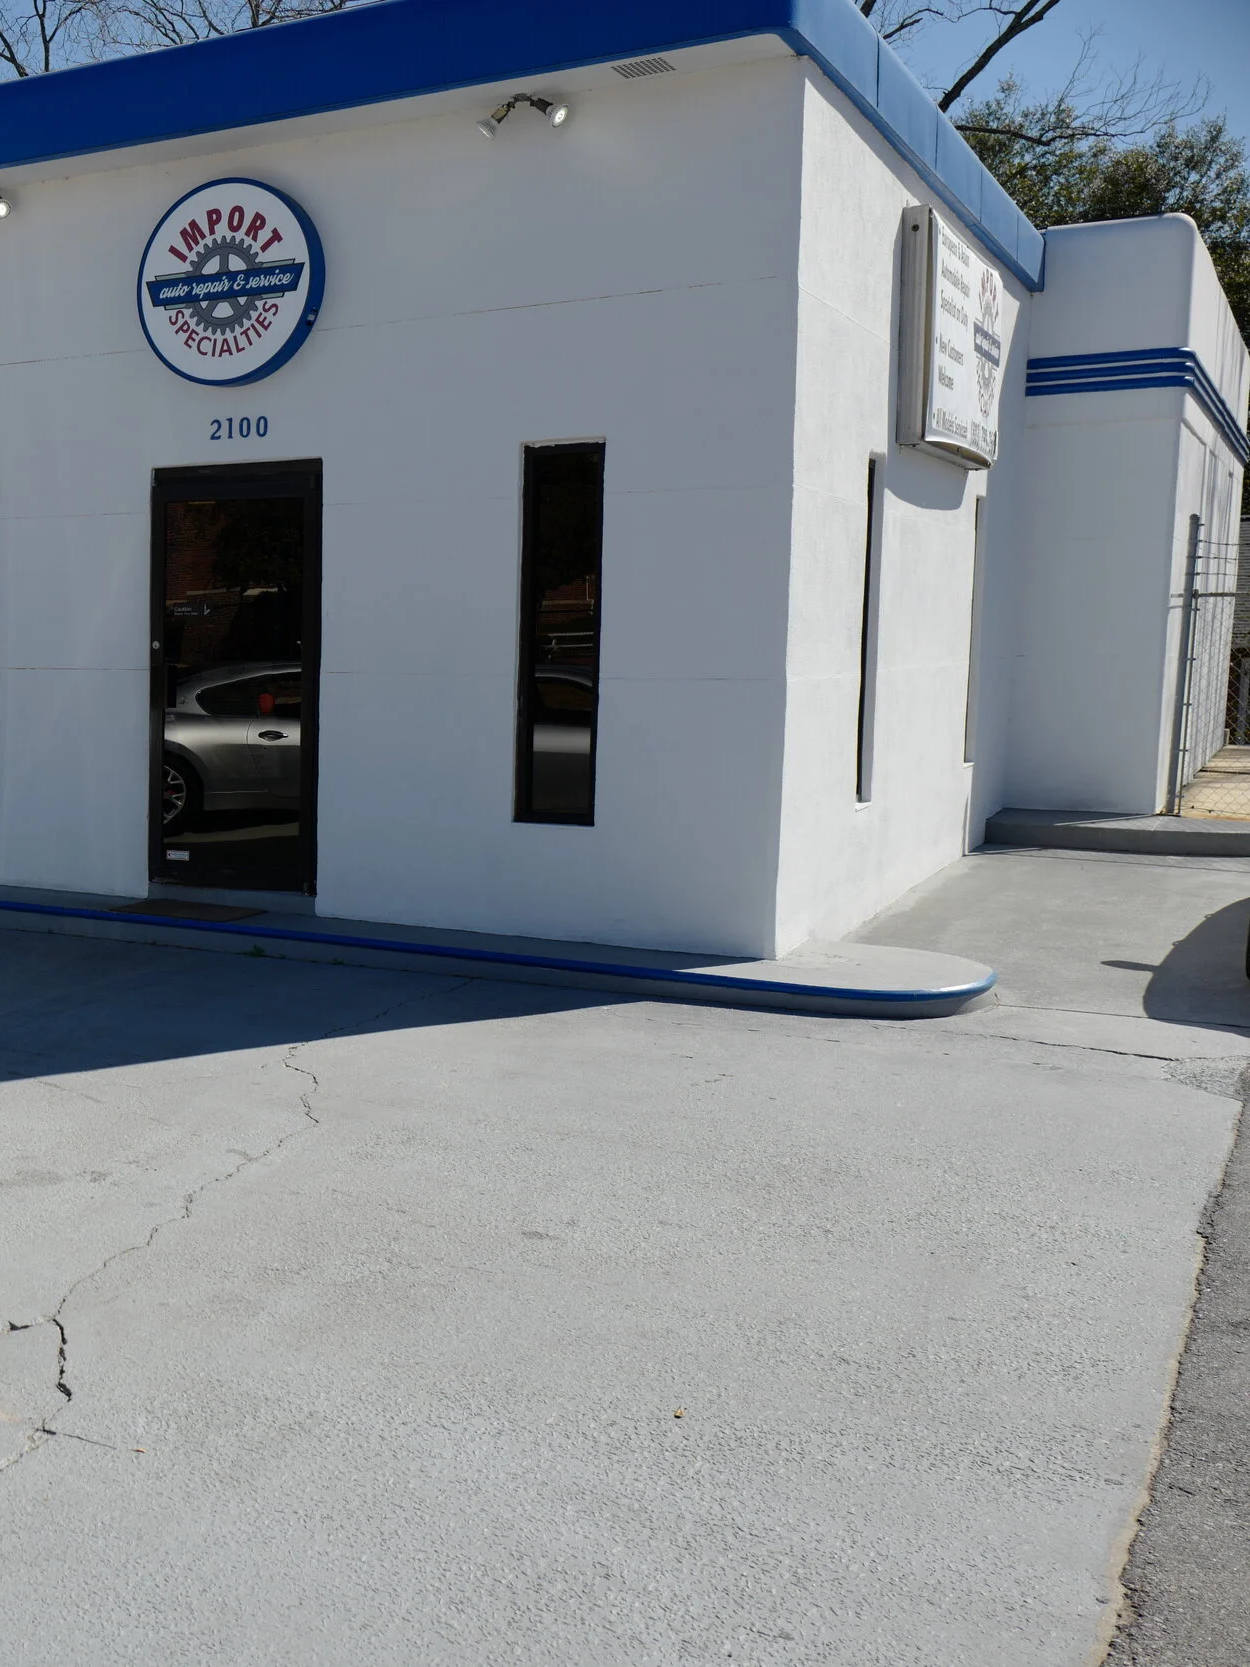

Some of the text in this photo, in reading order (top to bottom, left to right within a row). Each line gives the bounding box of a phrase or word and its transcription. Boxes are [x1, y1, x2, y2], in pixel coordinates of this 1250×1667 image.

[168, 205, 283, 263] IMPORT
[159, 269, 294, 300] auto repair & service
[168, 300, 279, 357] SPECIALTIES
[938, 364, 954, 391] Welcome
[210, 416, 268, 440] 2100
